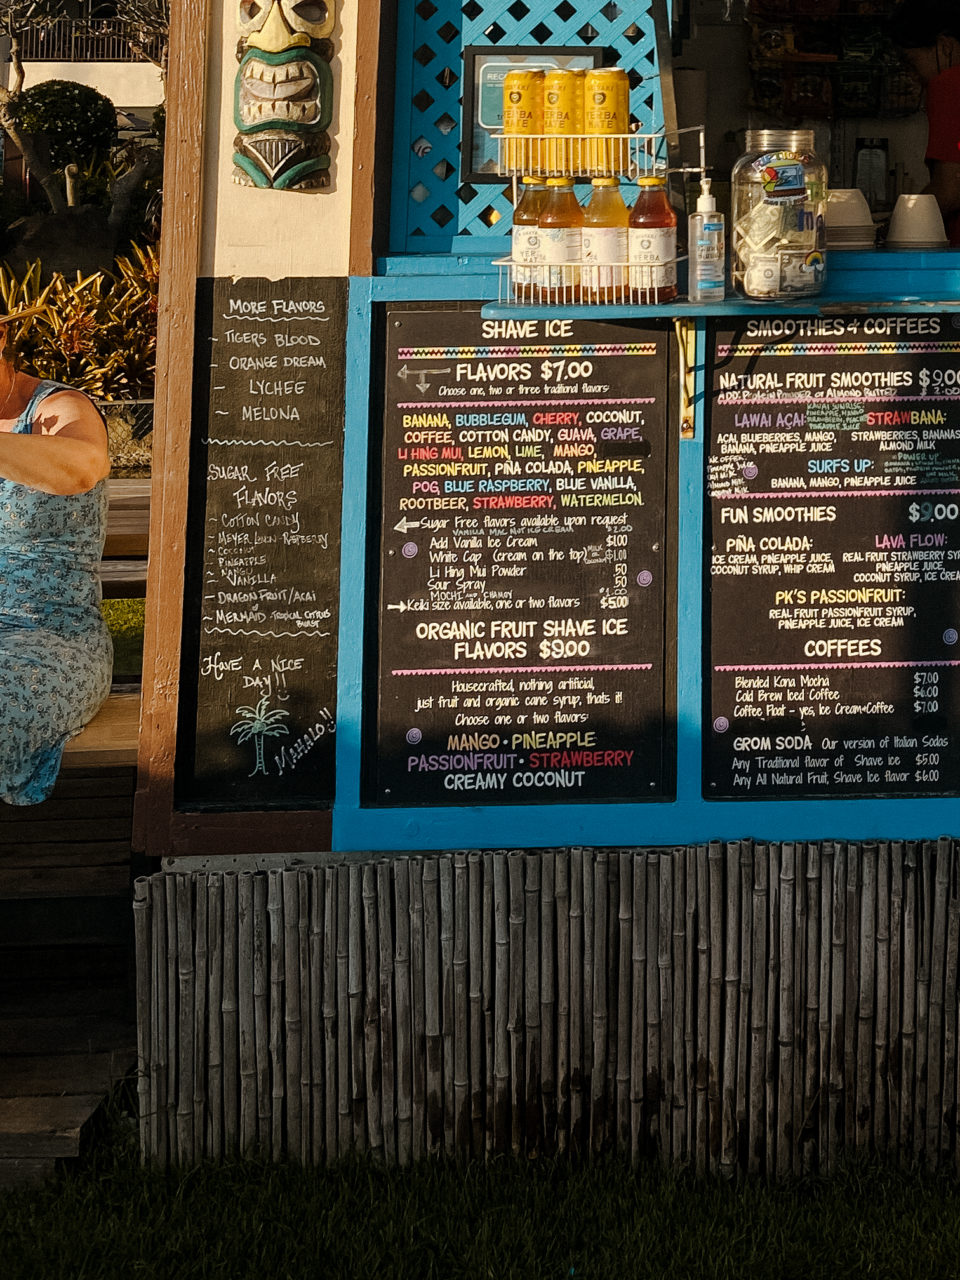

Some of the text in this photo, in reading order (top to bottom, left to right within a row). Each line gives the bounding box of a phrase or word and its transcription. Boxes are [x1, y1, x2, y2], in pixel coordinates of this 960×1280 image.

[229, 299, 325, 314] MORE FLAVORS
[482, 320, 573, 338] SHAVE ICE
[747, 320, 844, 337] SMOOTHIES
[863, 317, 940, 335] COFFEES
[224, 330, 320, 347] TIGERS BLOOD
[229, 356, 326, 370] ORANGE DREAM
[456, 360, 593, 383] FLAVORS $7.00
[250, 380, 306, 395] LYCHEE
[720, 373, 783, 390] NATURAL
[786, 372, 826, 388] FRUIT
[831, 371, 912, 387] SMOOTHIES
[242, 405, 300, 421] MELONA
[403, 411, 645, 428] BANANA, BUBBLEGUM, CHERRY, COCONUT,
[404, 427, 643, 445] COFFEE, COTTON CANDY, GUAVA, GRAPE,
[398, 444, 597, 462] LI HING MUI, LEMON, LIME, MANGO,
[207, 461, 304, 482] SUGAR FREE
[404, 460, 645, 477] PASSIONFRUIT, PIÑA COLADA, PINEAPPLE,
[808, 460, 849, 473] SURFS
[854, 459, 875, 472] UP:
[771, 475, 917, 490] BANANA, MANGO, PINEAPPLE JUICE
[233, 485, 298, 510] FLAVORS
[721, 502, 959, 524] FUN SMOOTHIES $9.00
[421, 513, 627, 533] Sugar Free flavors available upon request
[726, 536, 814, 552] PIÑA COLADA:
[227, 575, 277, 586] VANILLA
[811, 589, 906, 604] PASSIONFRUIT:
[769, 606, 917, 619] REAL FRUIT PASSIONFRUIT SYRUP,
[416, 619, 628, 640] ORGANIC FRUIT SHAVE ICE
[454, 639, 590, 660] FLAVORS $9.00
[804, 639, 882, 657] COFFEES
[253, 658, 262, 670] A
[271, 655, 304, 672] NICE
